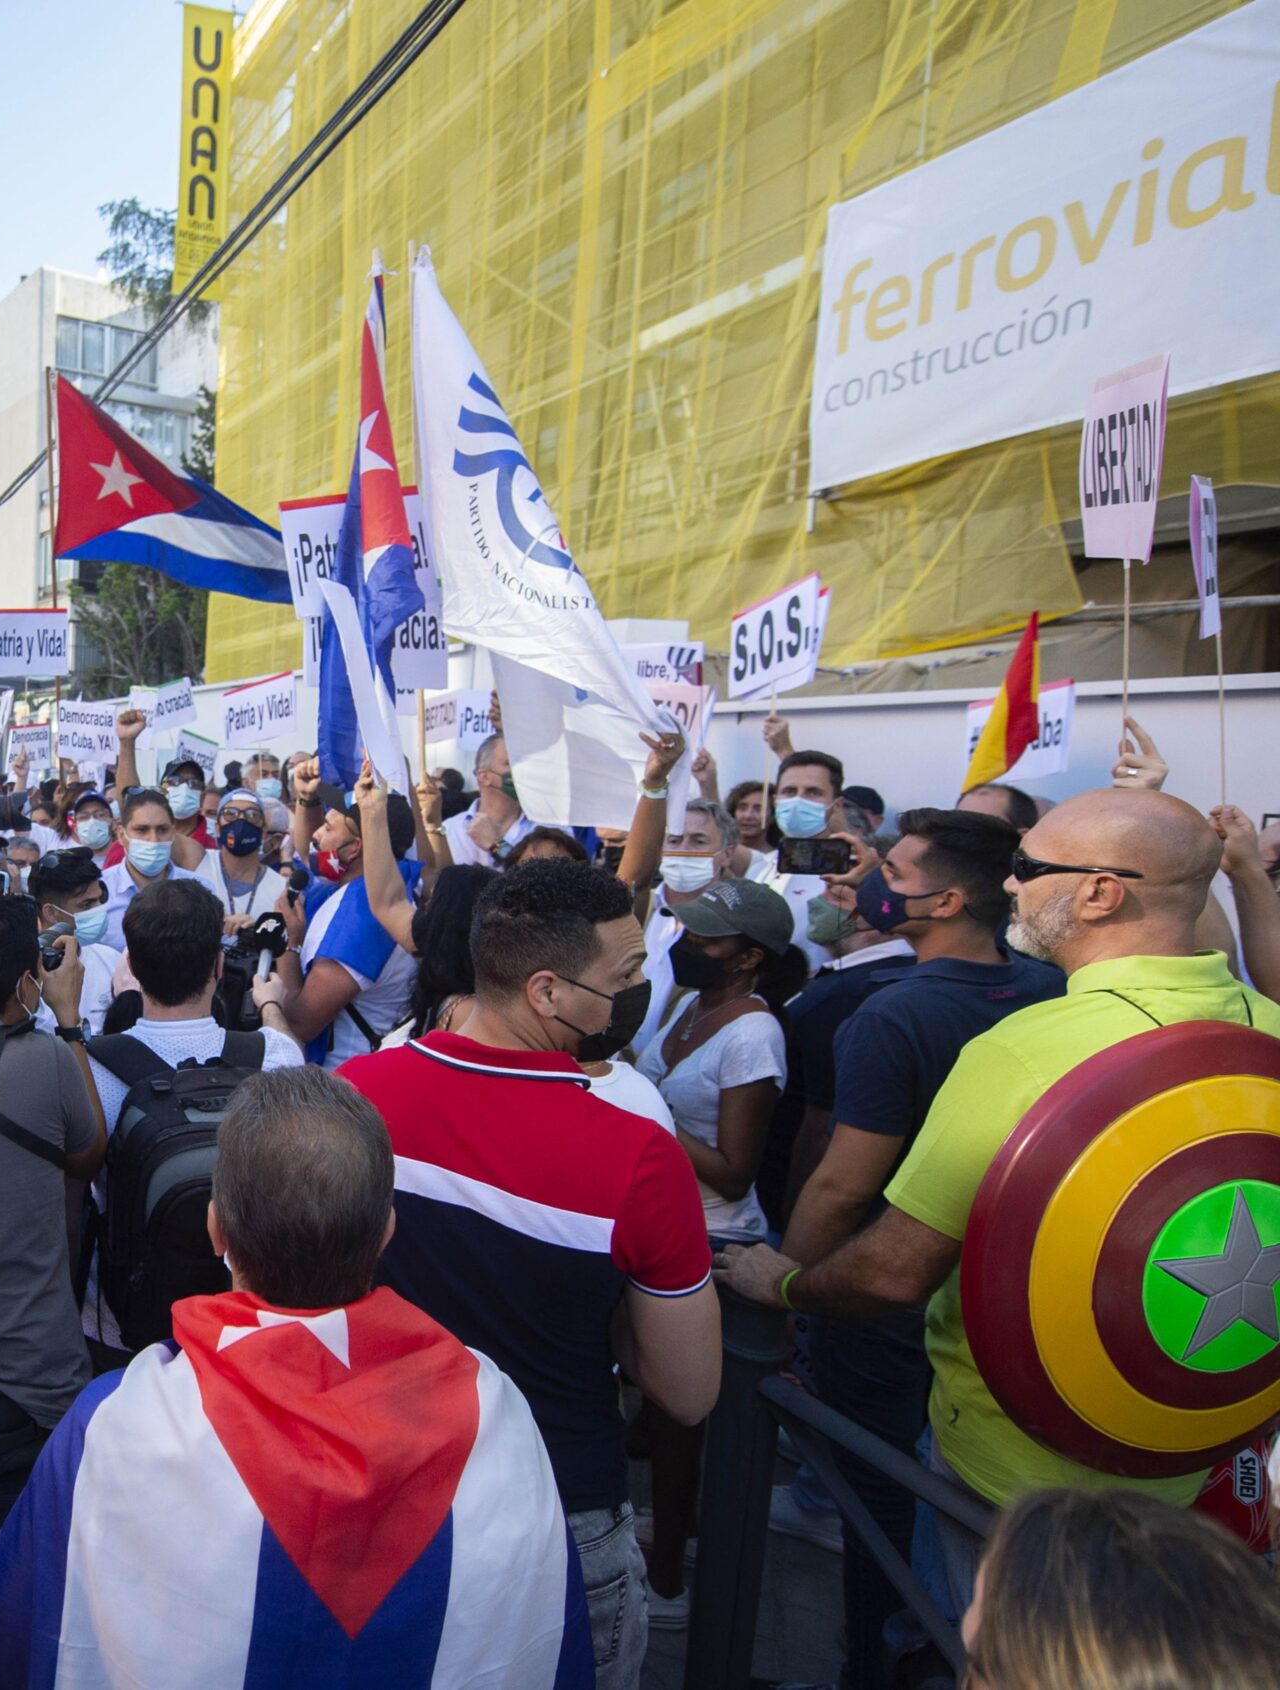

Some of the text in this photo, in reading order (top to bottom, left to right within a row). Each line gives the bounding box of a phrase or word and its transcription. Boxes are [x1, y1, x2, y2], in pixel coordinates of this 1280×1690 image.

[832, 80, 1280, 357] ferrovial
[824, 295, 1093, 413] construcción
[1083, 399, 1157, 508] LIBERTAD!
[469, 482, 491, 560] PARTIDO
[492, 561, 598, 611] NACIONALIST
[26, 640, 35, 664] y
[37, 629, 67, 657] Vida!
[734, 595, 810, 682] S.O.S.
[11, 729, 49, 745] Democracia
[59, 706, 113, 727] Democracia
[225, 690, 294, 741] ¡Patria y Vida!
[59, 732, 114, 751] en Cuba, YA!
[1239, 1456, 1257, 1499] SHOEI
